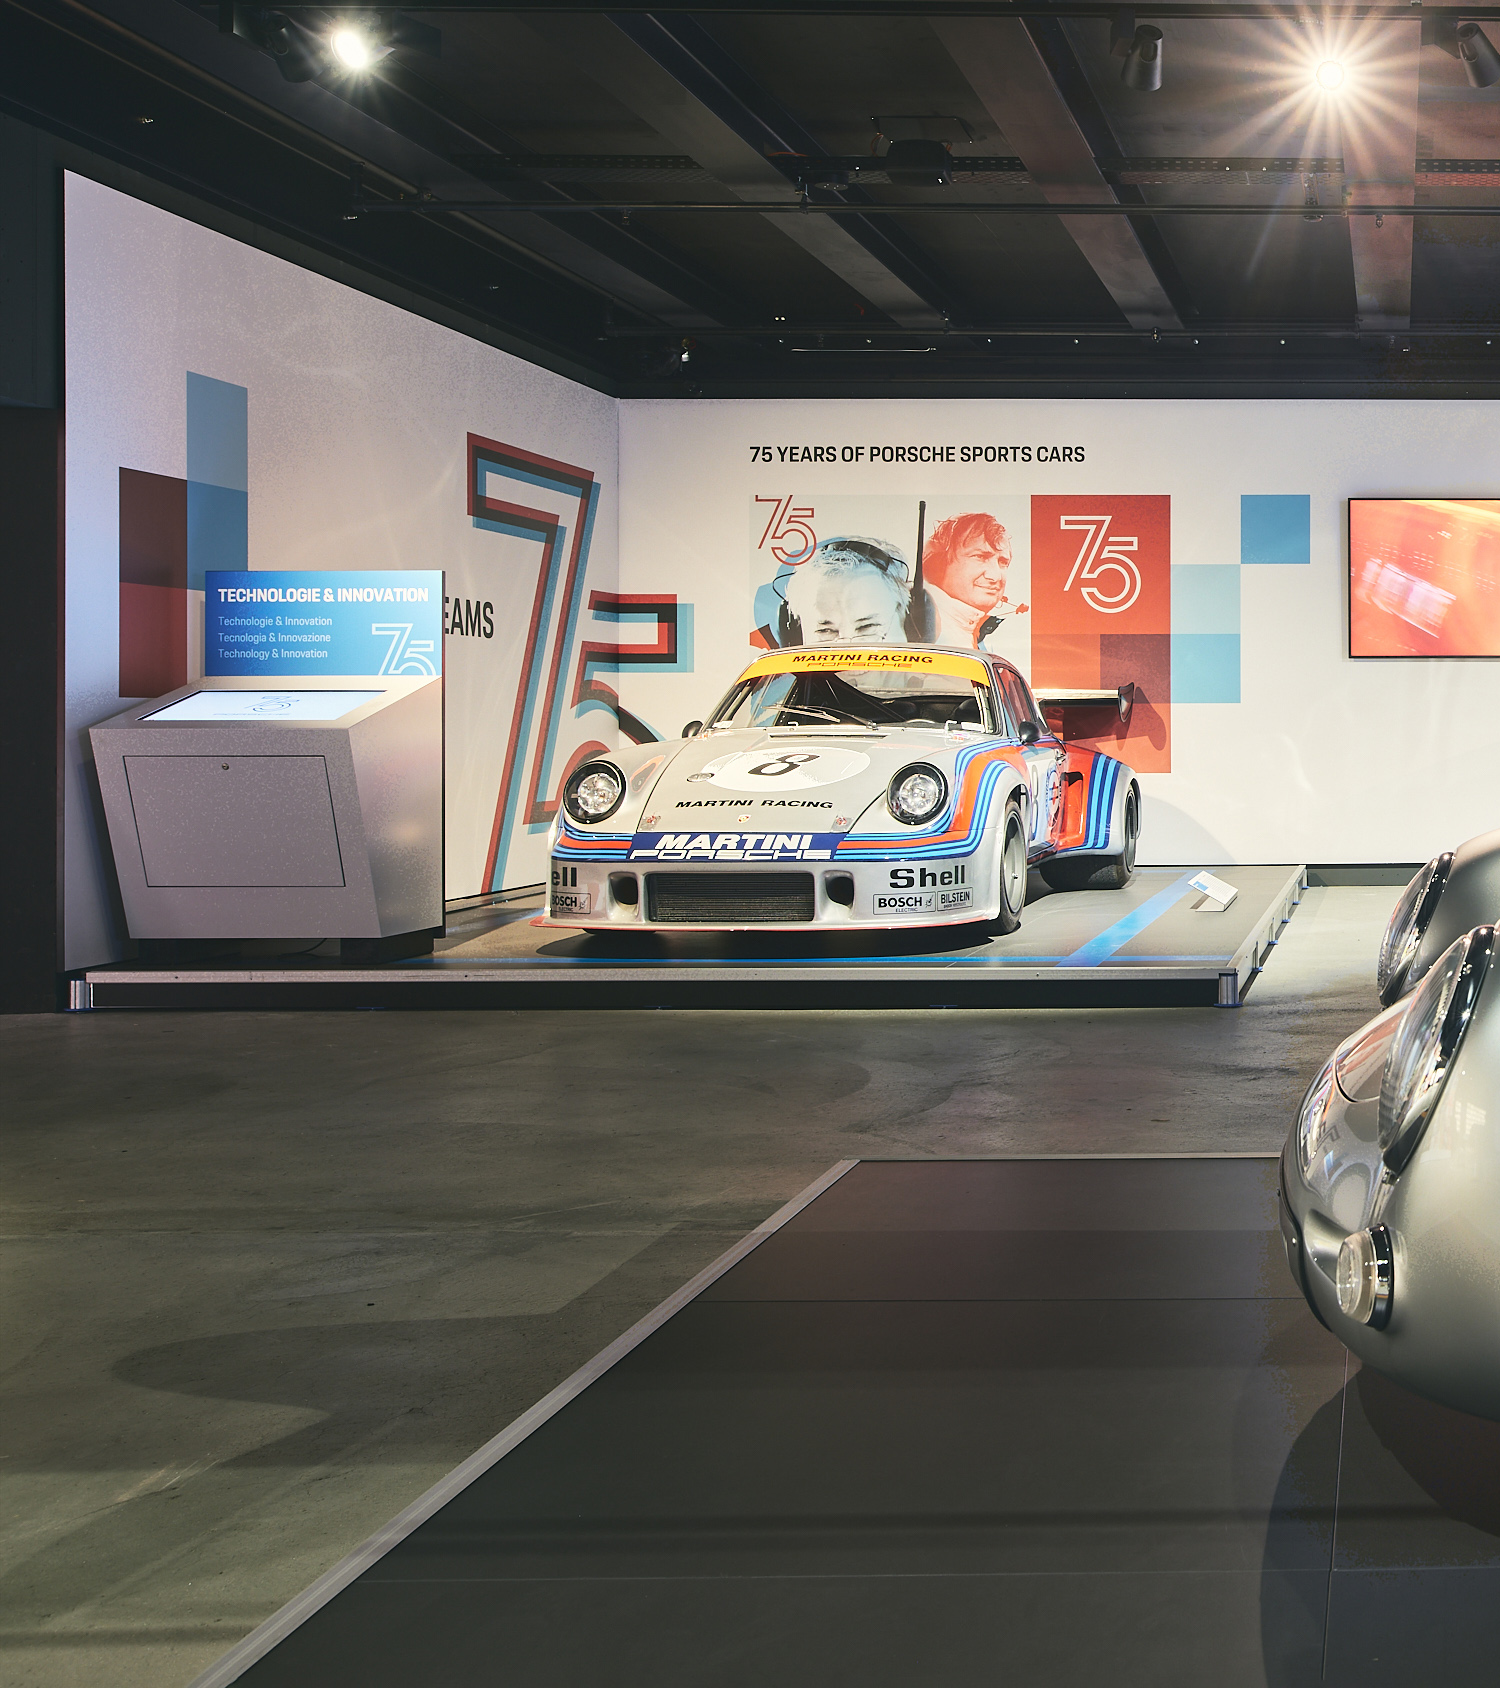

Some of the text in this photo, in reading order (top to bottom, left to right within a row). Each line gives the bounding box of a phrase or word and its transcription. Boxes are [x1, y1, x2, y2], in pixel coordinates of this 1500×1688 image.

[750, 446, 1085, 463] 75 YEARS OF PORSCHE SPORTS CARS
[755, 494, 817, 567] 75
[1060, 515, 1142, 614] 75
[218, 587, 429, 603] TECHNOLOGIE & INNOVATION
[218, 616, 333, 627] Technologie & Innovation
[218, 632, 331, 643] Tecnologia & Innovazione
[218, 649, 328, 661] Technology & Innovation
[371, 623, 437, 676] 75
[792, 654, 933, 664] MARTINI RACING
[747, 753, 821, 777] 8
[675, 799, 833, 809] MARTINI RACING
[654, 833, 814, 850] MARTINI
[629, 849, 832, 861] PORSCHE
[551, 866, 577, 887] ell
[889, 864, 966, 889] Shell
[878, 896, 923, 908] BOSCH
[940, 890, 970, 904] BILSTEIN
